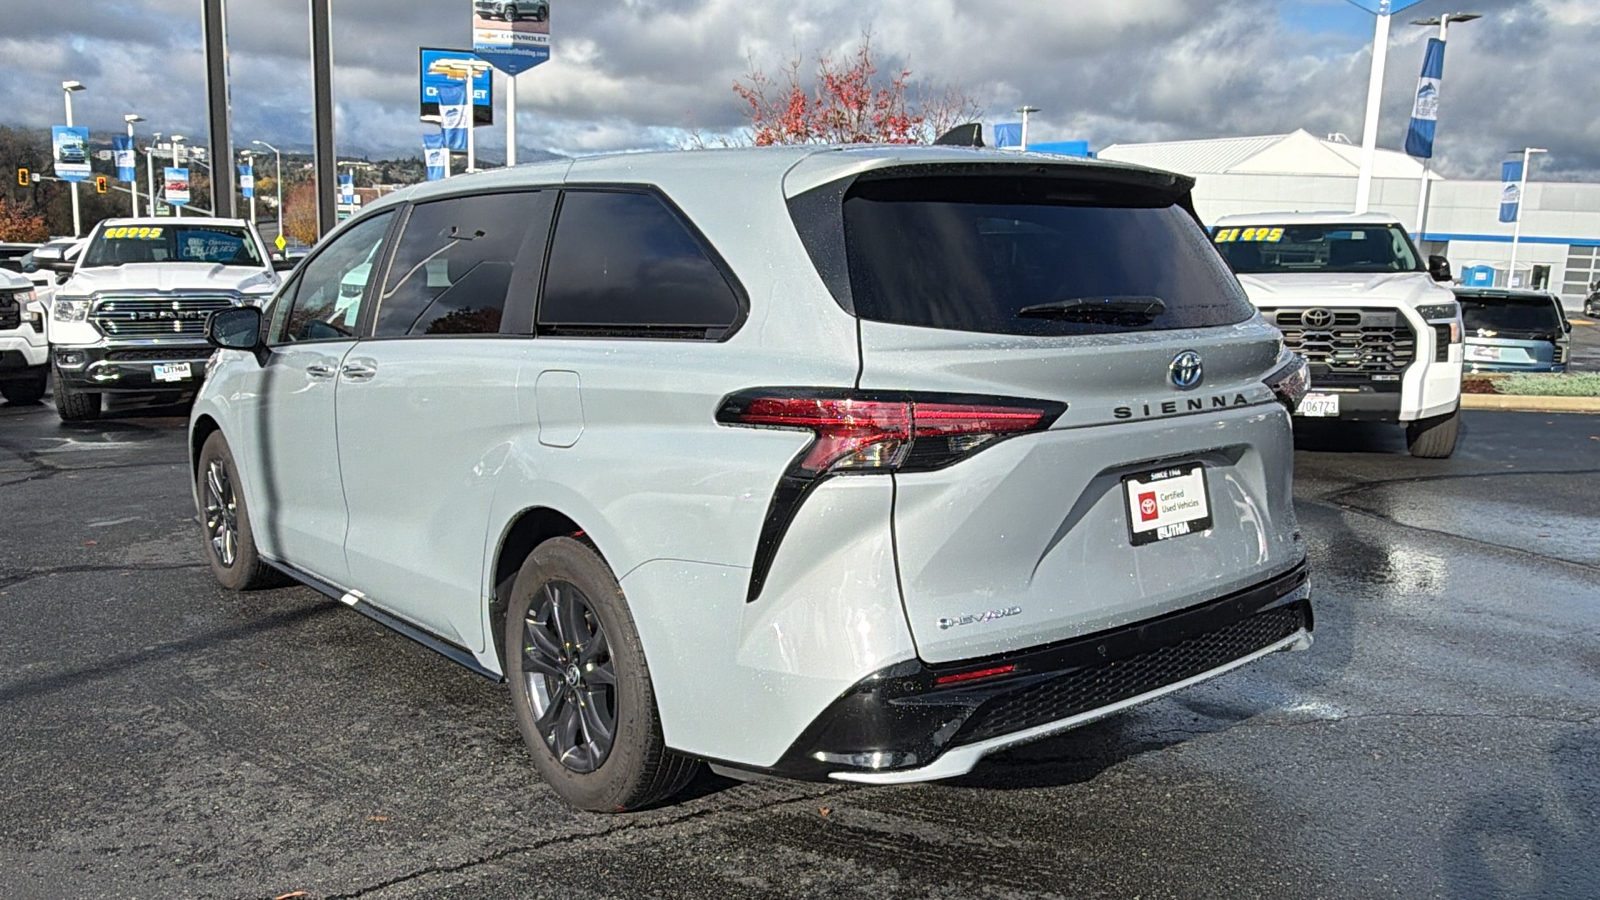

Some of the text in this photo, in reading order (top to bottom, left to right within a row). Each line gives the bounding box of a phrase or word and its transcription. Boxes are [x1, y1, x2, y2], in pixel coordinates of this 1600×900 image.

[501, 33, 548, 43] CHEVROLET
[104, 227, 163, 239] 60995
[163, 365, 189, 374] LITHIA
[1113, 393, 1248, 419] SIENNA
[1150, 469, 1168, 480] SINCE
[1160, 489, 1185, 502] Certified
[1161, 499, 1199, 513] Used Vehicles
